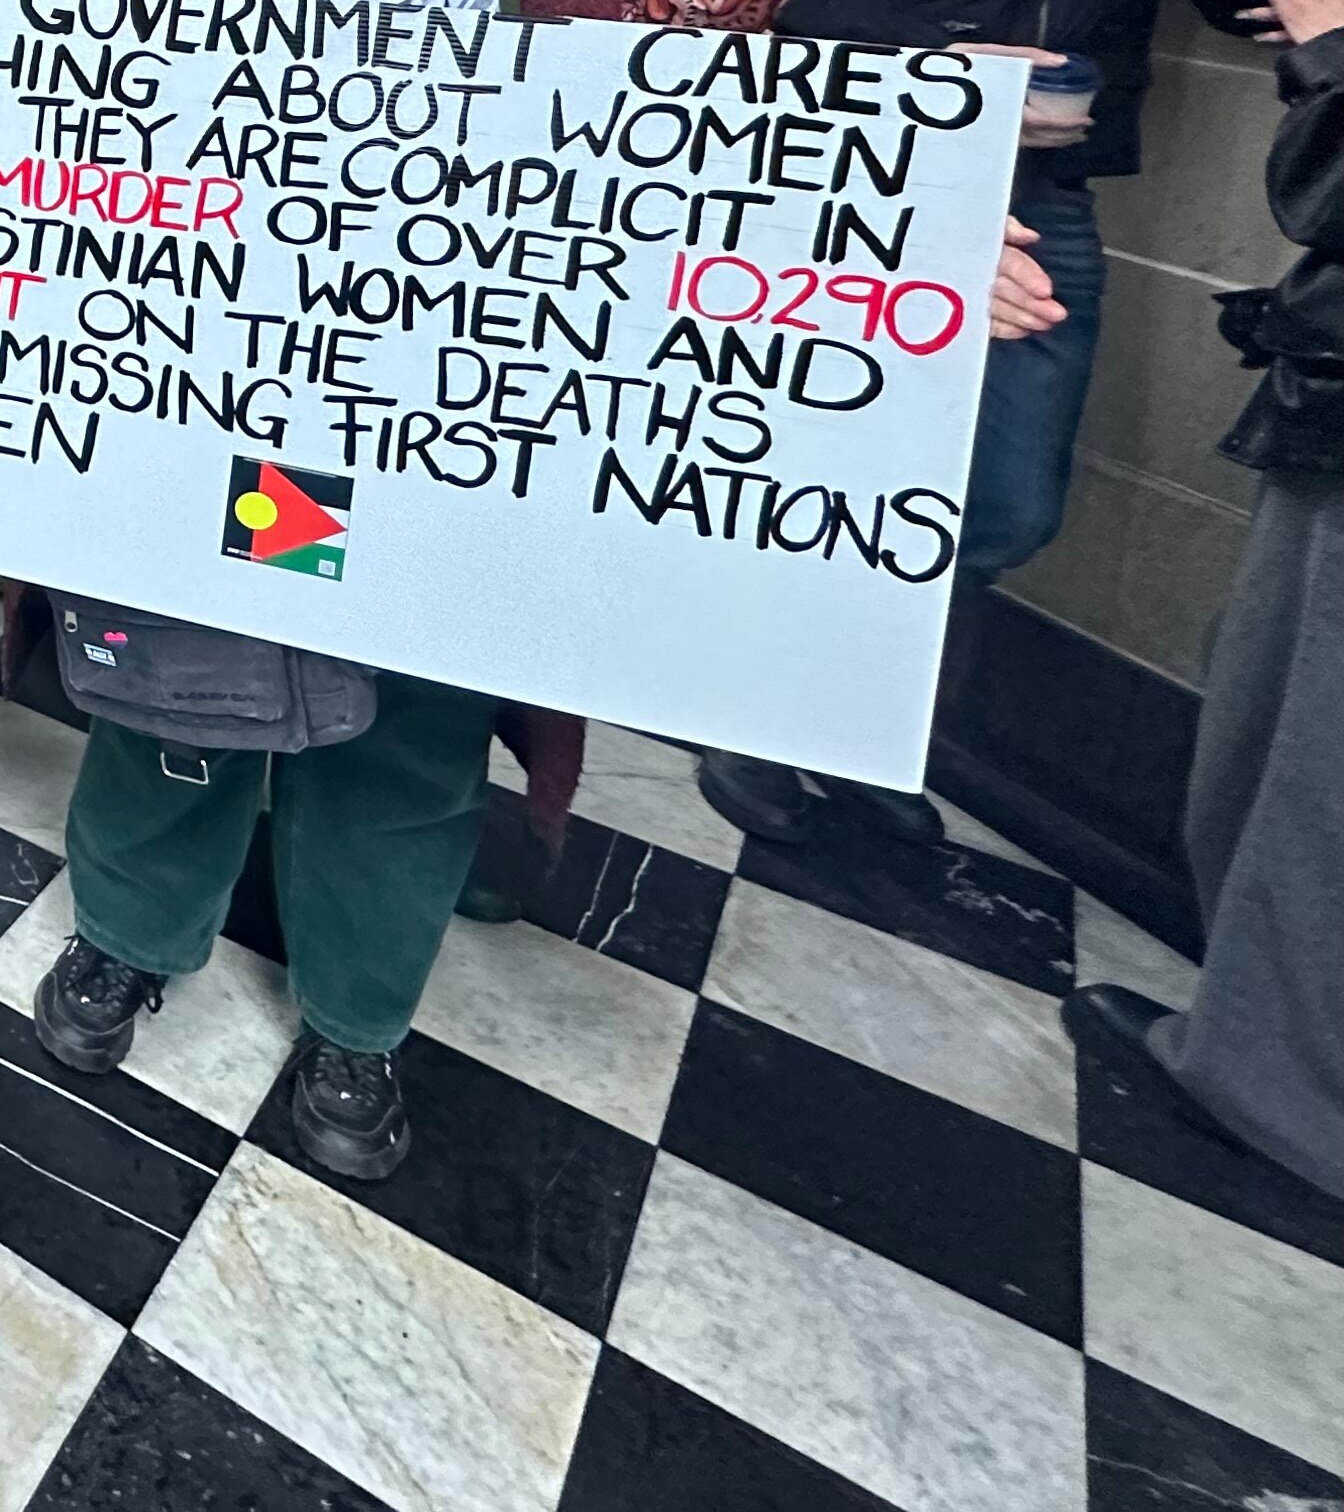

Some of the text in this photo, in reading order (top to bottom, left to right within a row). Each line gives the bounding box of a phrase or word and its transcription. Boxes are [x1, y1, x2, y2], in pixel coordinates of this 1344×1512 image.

[212, 59, 502, 147] ABOUT
[551, 88, 919, 197] WOMEN
[627, 26, 984, 130] CARES
[18, 96, 178, 172] THEY
[186, 116, 328, 190] ARE
[340, 138, 776, 252] COMPLICIT
[812, 200, 914, 272] IN
[267, 196, 378, 251] OF
[397, 214, 630, 301] OVER
[667, 252, 964, 356] 10,290
[297, 253, 611, 362] WOMEN
[647, 316, 884, 411] AND
[78, 290, 194, 354] ON
[225, 310, 382, 392] THE
[436, 346, 773, 463] DEATHS
[322, 394, 557, 498] FIRST
[592, 446, 961, 584] NATIONS
